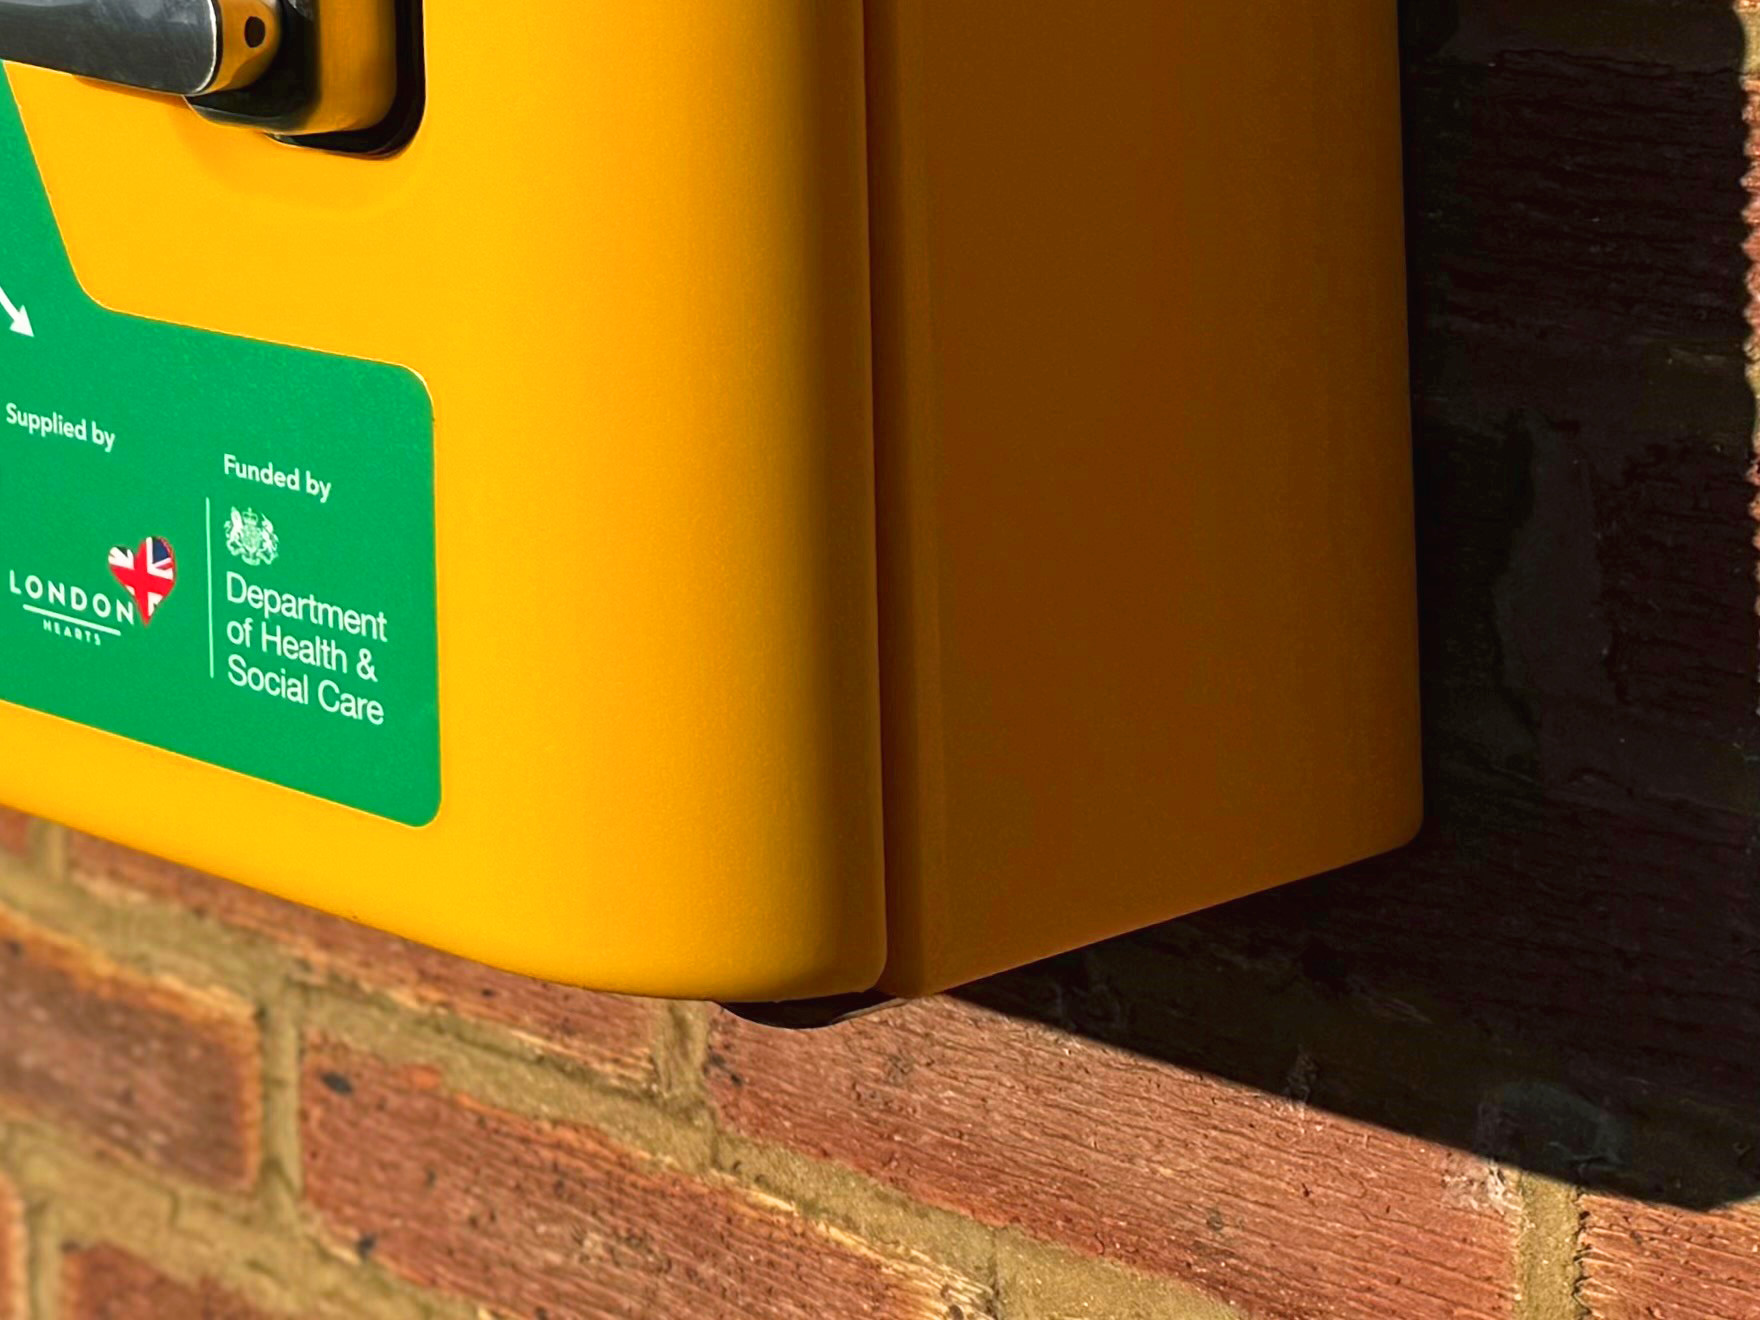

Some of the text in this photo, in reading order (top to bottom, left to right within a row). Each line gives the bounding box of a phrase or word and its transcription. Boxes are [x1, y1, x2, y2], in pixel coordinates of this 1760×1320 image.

[5, 401, 117, 453] Supplied by
[223, 452, 332, 504] Funded by
[8, 569, 136, 626] LONDON
[226, 571, 388, 643] Department
[226, 616, 379, 683] of Health &
[227, 654, 385, 727] Social Care
